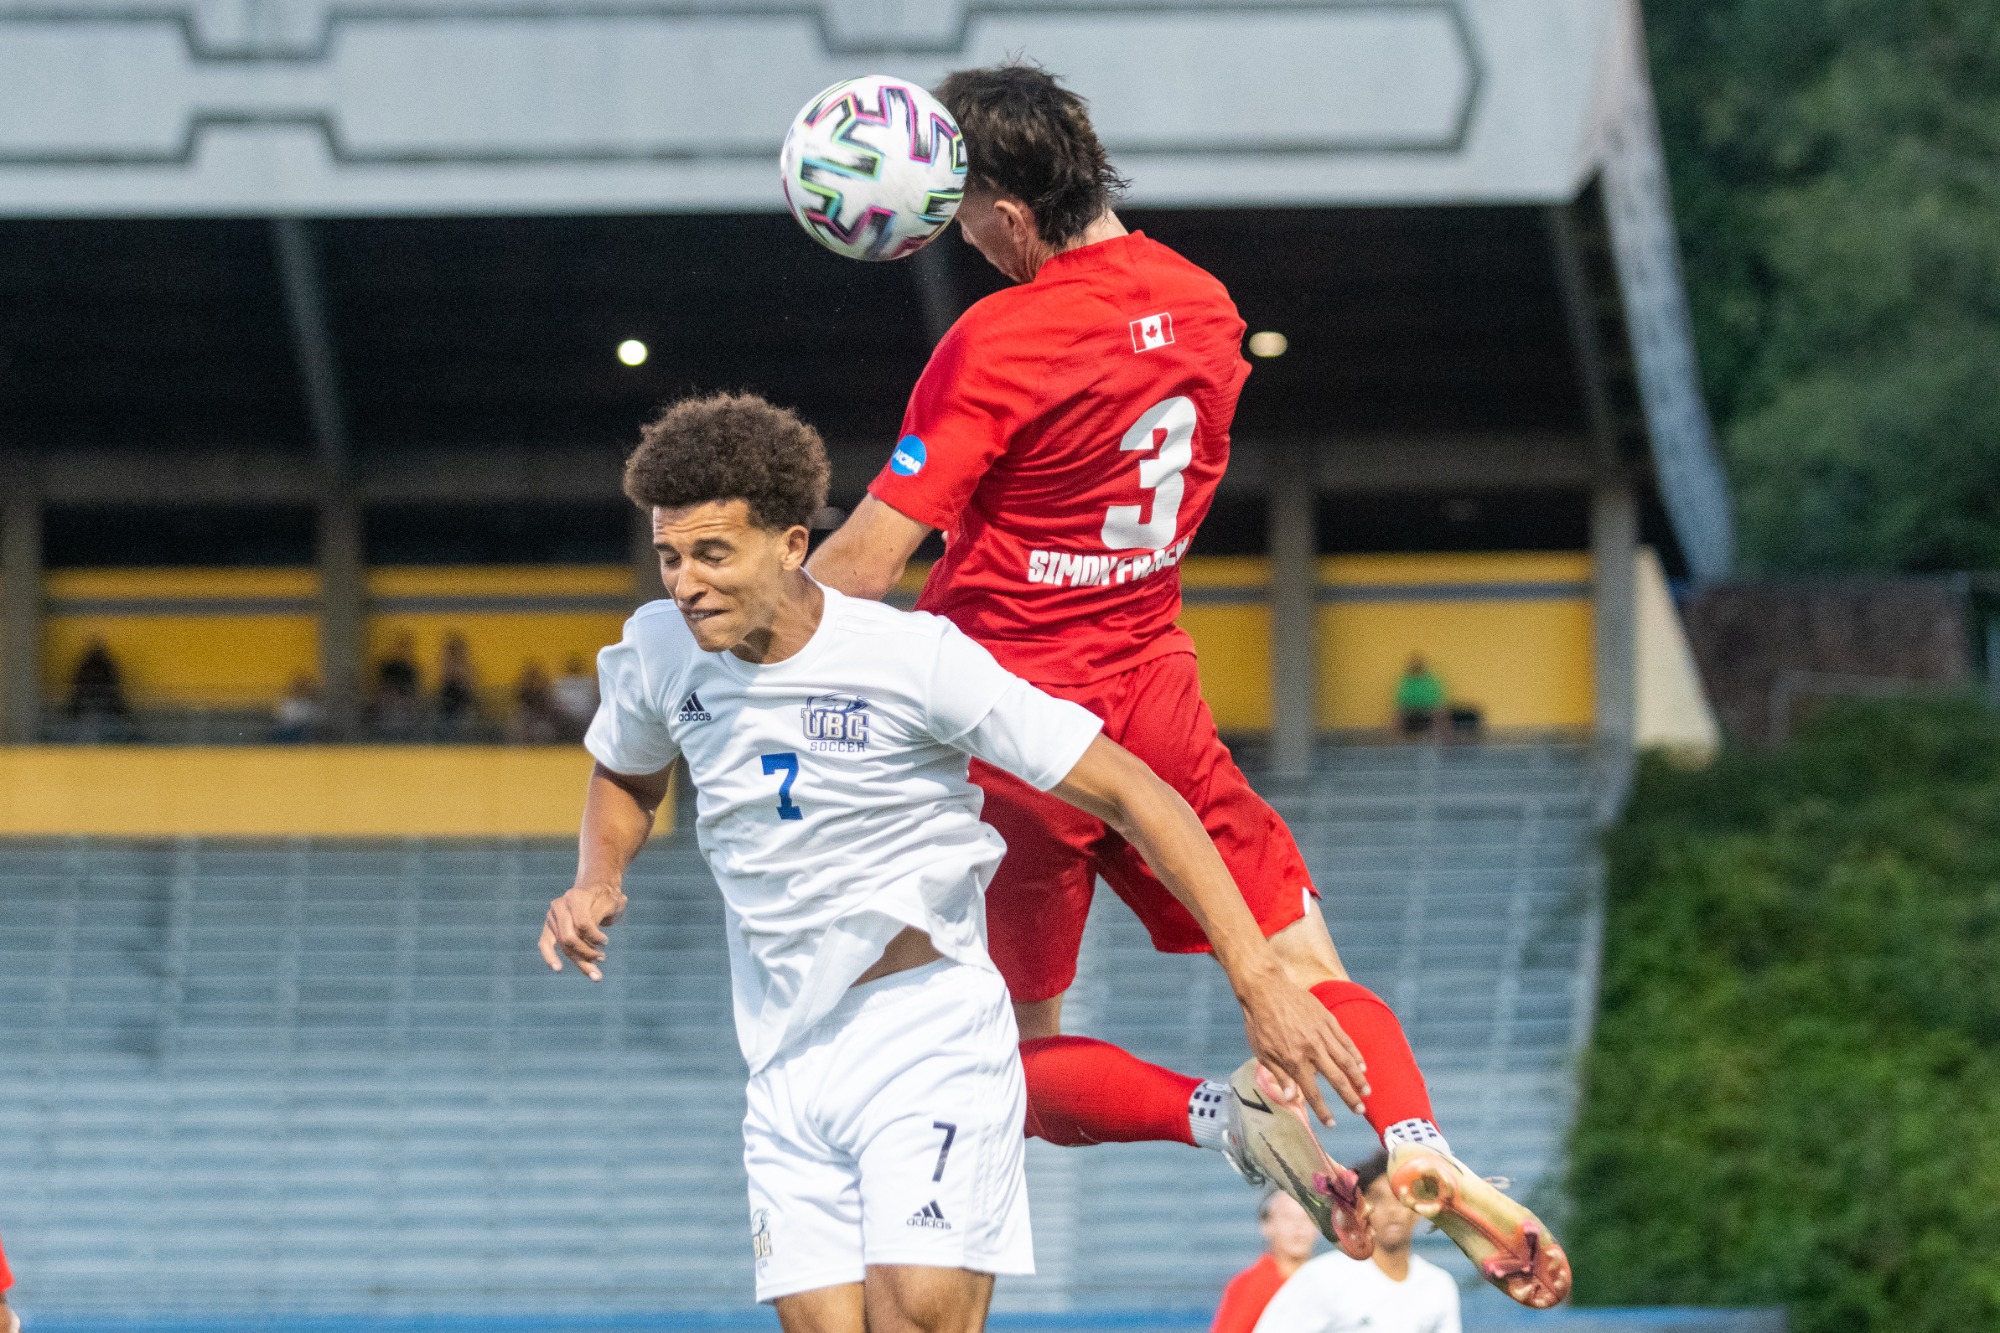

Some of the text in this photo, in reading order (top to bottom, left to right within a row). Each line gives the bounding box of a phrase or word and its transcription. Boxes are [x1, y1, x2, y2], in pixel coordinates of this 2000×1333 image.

[893, 449, 922, 474] NCAA
[1101, 395, 1197, 550] 3
[1027, 549, 1119, 587] SIMON
[678, 711, 712, 722] adidas
[801, 707, 869, 743] UBC
[810, 741, 866, 752] SOCCER
[761, 752, 804, 820] 7
[932, 1121, 957, 1182] 7
[906, 1217, 952, 1230] adidas
